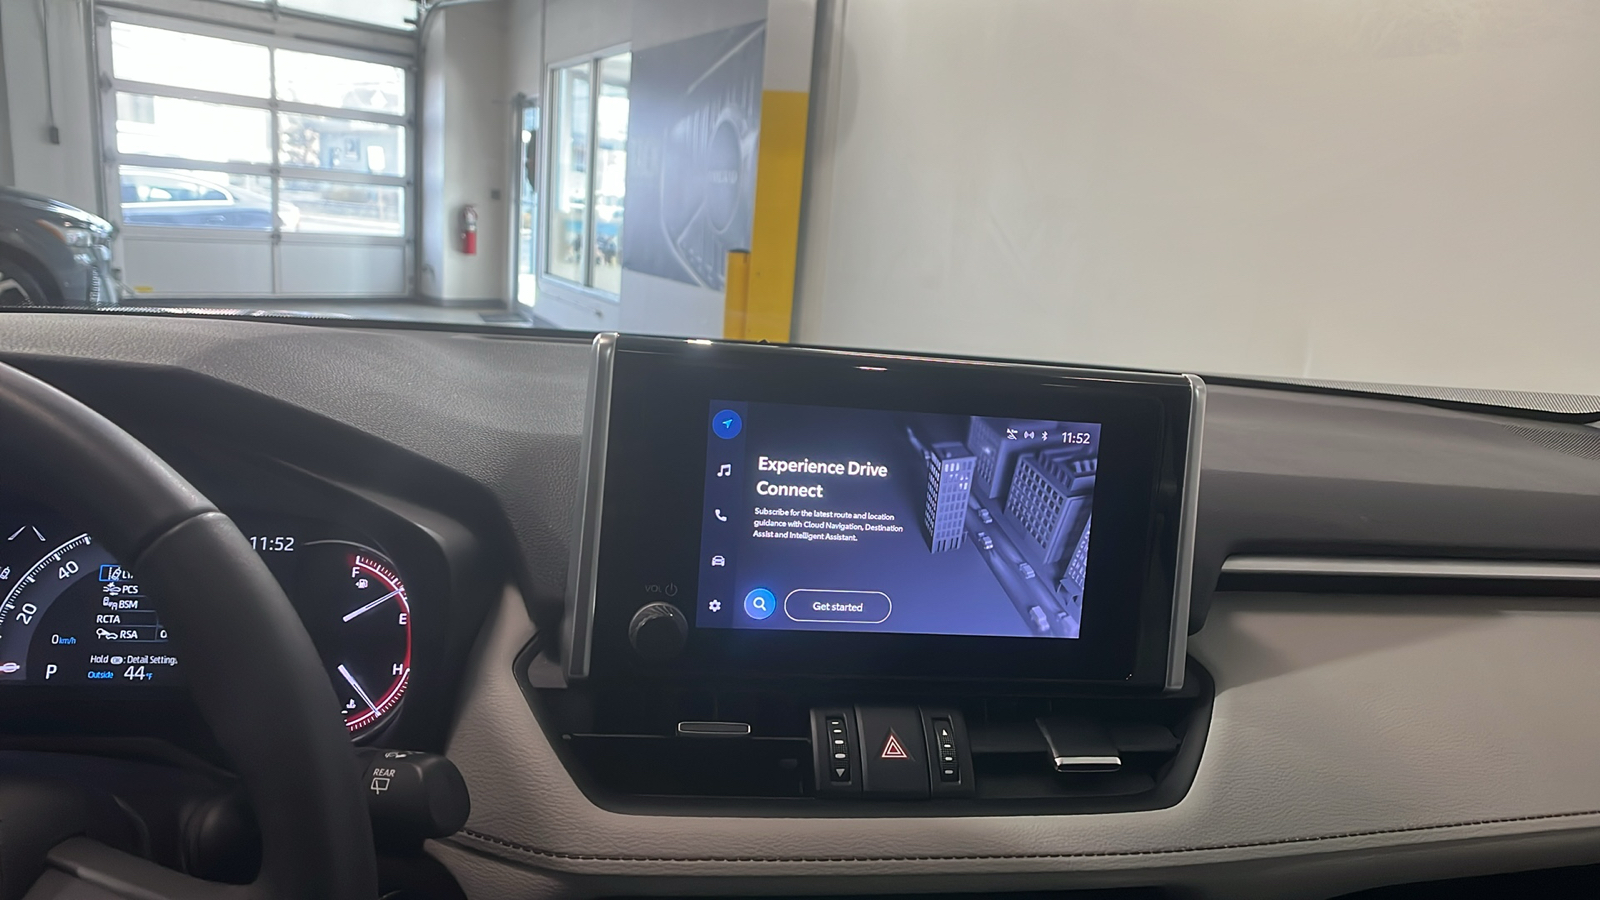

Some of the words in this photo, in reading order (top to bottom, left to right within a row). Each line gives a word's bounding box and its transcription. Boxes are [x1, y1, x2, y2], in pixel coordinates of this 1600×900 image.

[1061, 432, 1091, 444] 11:52
[758, 456, 845, 475] Experience
[847, 461, 888, 478] Drive
[756, 480, 824, 498] Connect
[754, 507, 789, 517] Subscribe
[790, 508, 800, 517] for
[801, 509, 813, 518] the
[813, 510, 833, 519] latest
[834, 511, 853, 519] route
[853, 512, 868, 520] and
[867, 512, 895, 521] location
[753, 519, 787, 528] guidance
[787, 520, 803, 528] with
[803, 521, 825, 529] Cloud
[825, 521, 864, 532] Navigation,
[864, 523, 904, 533] Destination
[752, 530, 774, 539] Assist
[774, 531, 789, 539] and
[789, 531, 825, 542] Intelligent
[824, 533, 858, 542] Assistant.
[250, 536, 295, 551] 11:52
[58, 561, 79, 580] 40
[352, 567, 360, 578] F
[122, 585, 139, 594] PCS
[644, 584, 662, 593] VOL
[118, 600, 139, 609] BSM
[812, 601, 830, 611] Get
[831, 602, 864, 612] started
[16, 603, 37, 625] 20
[96, 614, 121, 623] RCTA
[398, 613, 407, 625] E
[120, 630, 138, 639] RSA
[90, 655, 110, 664] Hold
[127, 655, 149, 664] Detail
[45, 664, 58, 680] P
[87, 671, 114, 679] Outside
[392, 663, 403, 675] H
[373, 767, 396, 778] REAR
